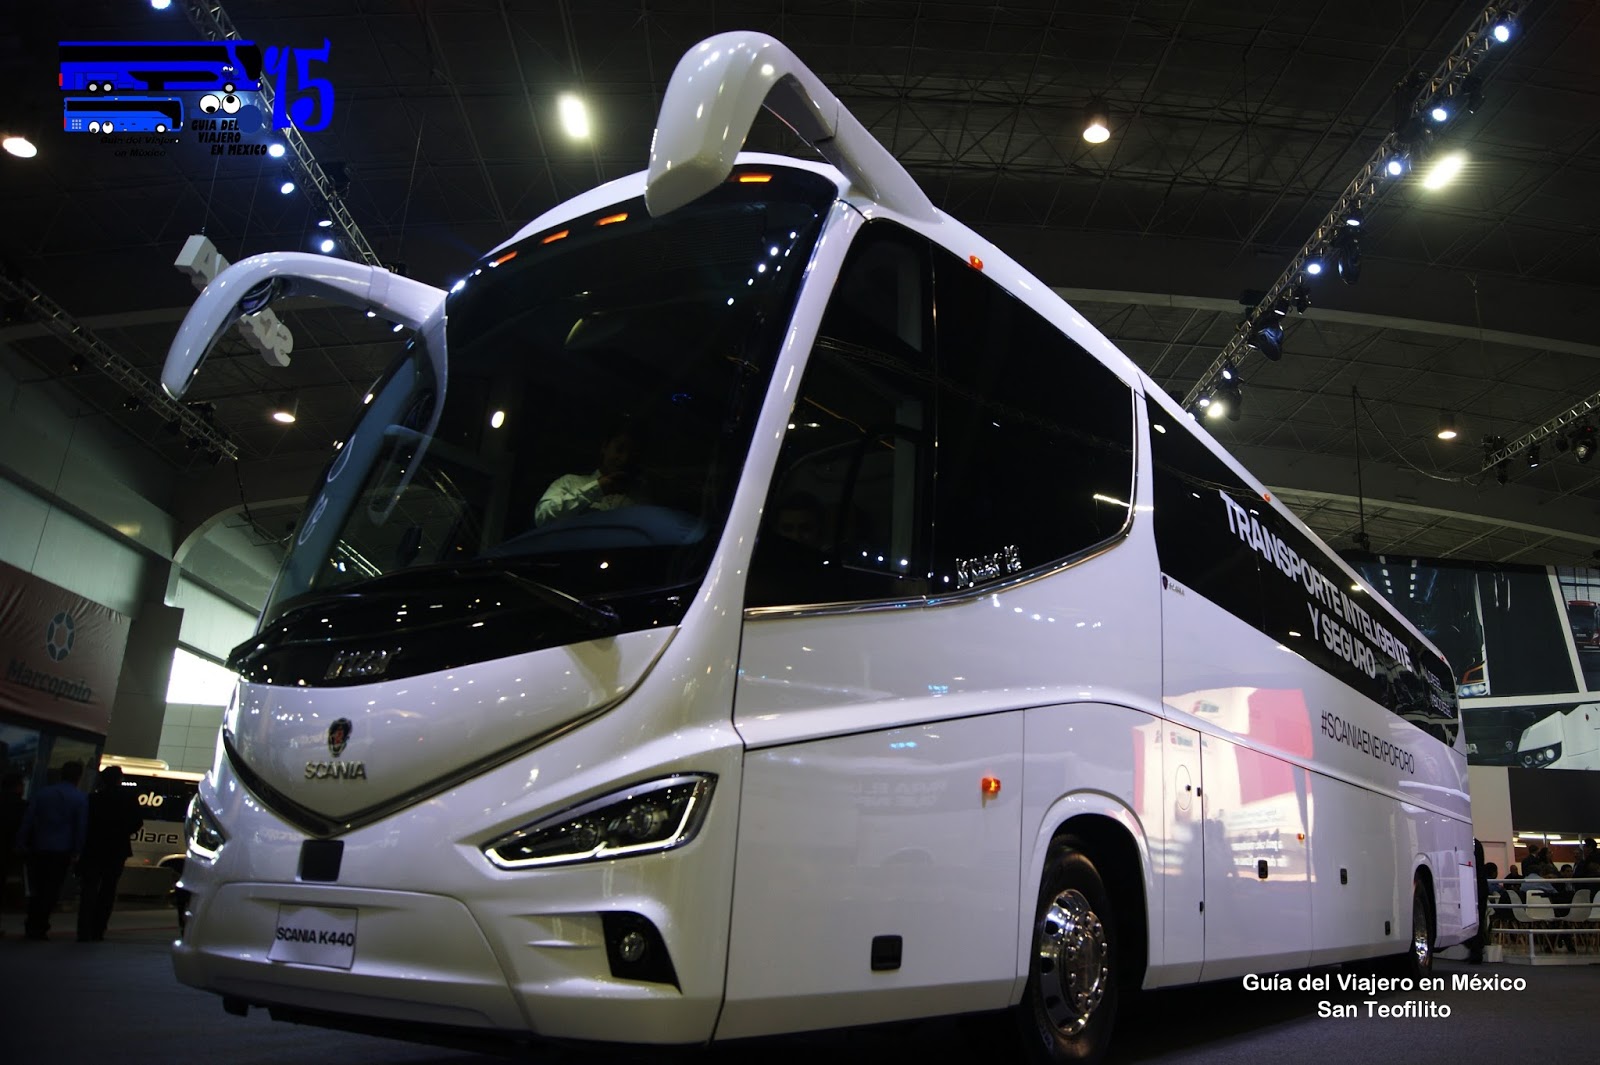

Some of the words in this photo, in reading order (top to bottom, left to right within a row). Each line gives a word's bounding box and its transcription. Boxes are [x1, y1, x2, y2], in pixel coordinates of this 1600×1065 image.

[1219, 489, 1344, 617] TRANSPORTE
[1340, 590, 1413, 673] INTELIGENTE
[1307, 602, 1320, 641] Y
[1321, 615, 1376, 680] SEGURO
[304, 760, 368, 781] SCANIA
[1321, 709, 1415, 775] #SCANIAENEXPOFORO
[276, 926, 318, 944] SCANIA
[318, 929, 355, 948] K440
